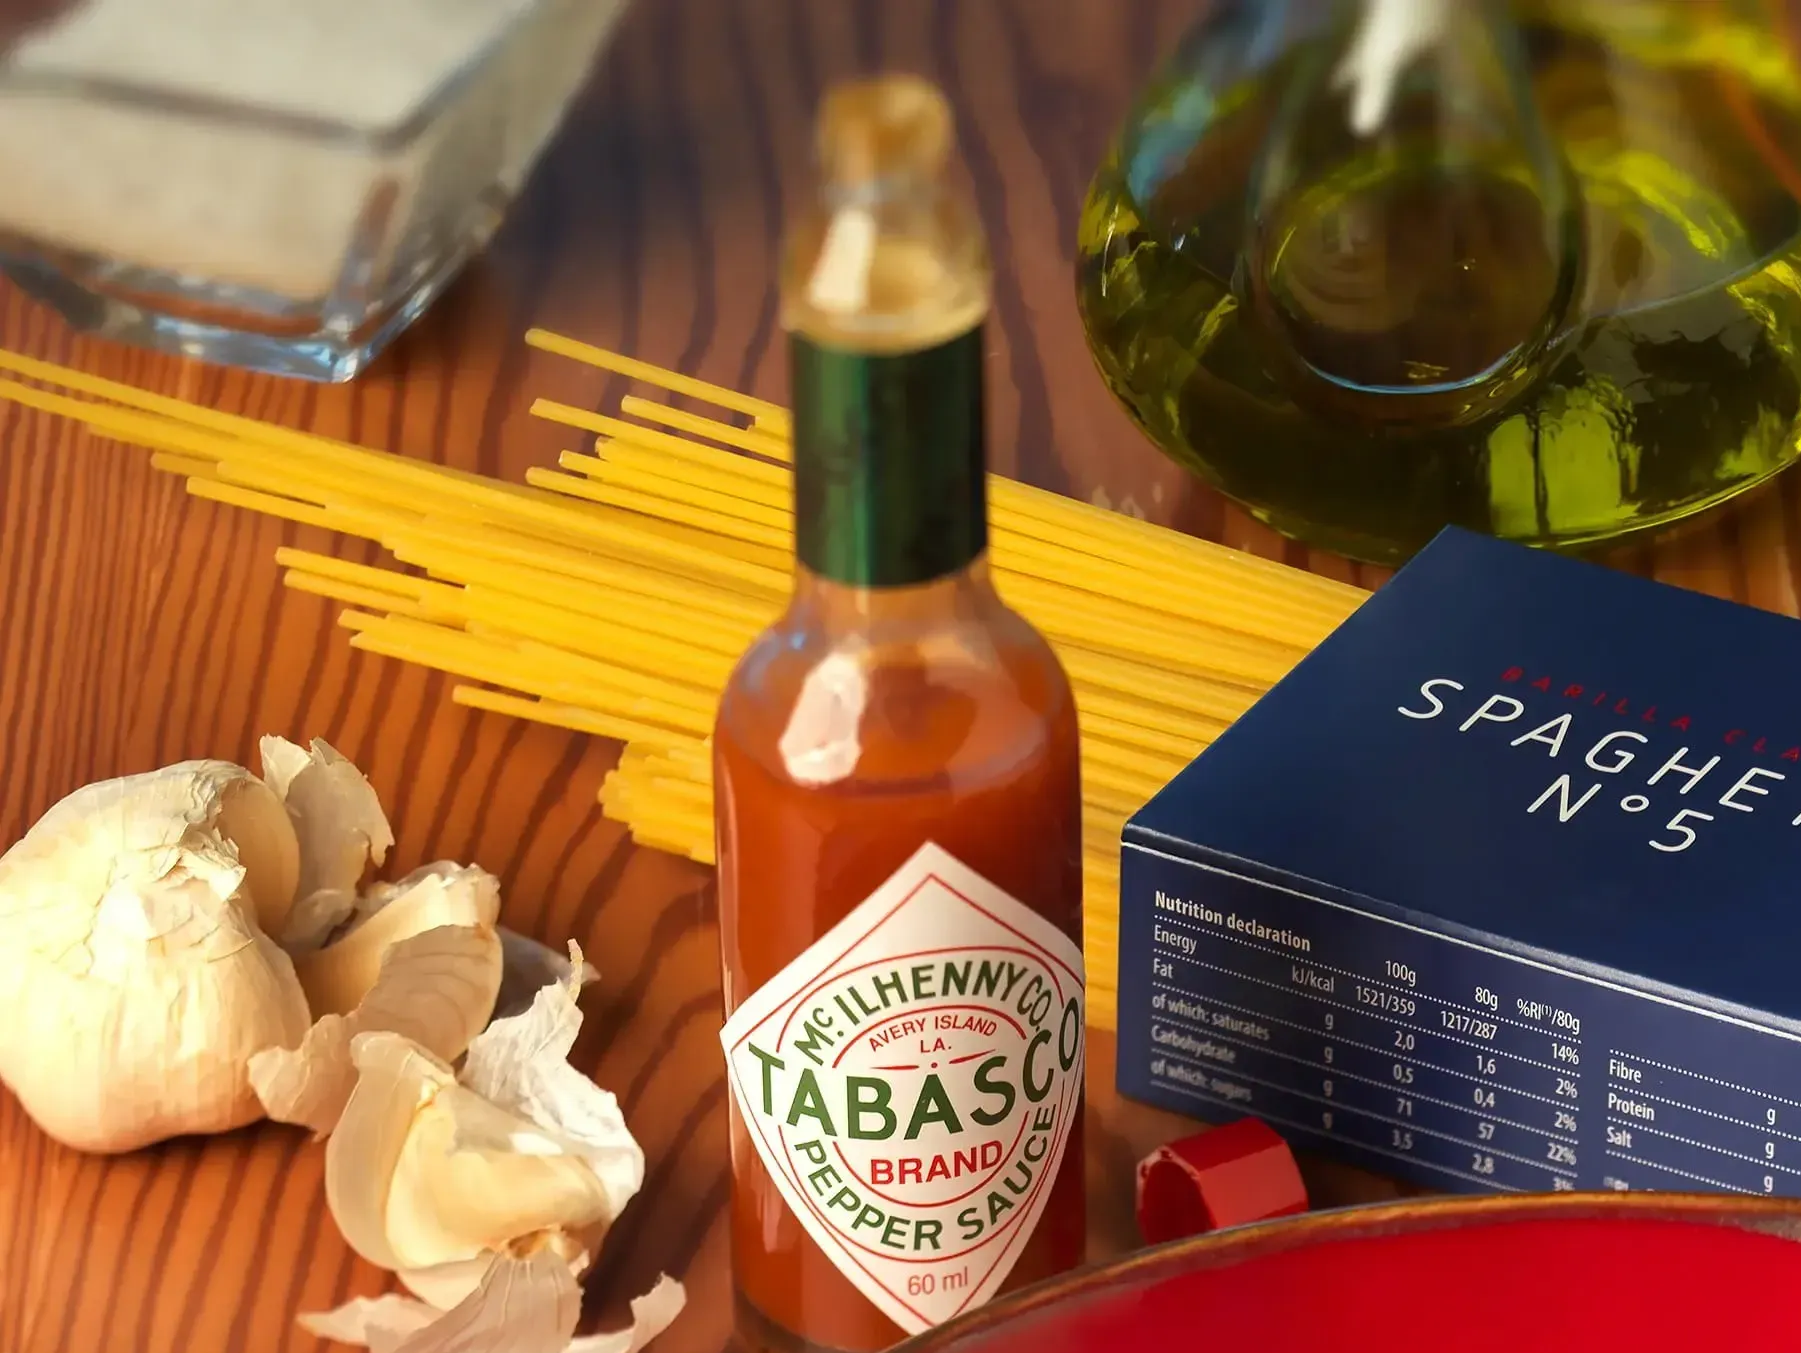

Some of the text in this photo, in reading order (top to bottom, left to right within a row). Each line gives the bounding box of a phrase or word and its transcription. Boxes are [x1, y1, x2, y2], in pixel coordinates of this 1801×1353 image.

[1501, 665, 1692, 732] BARILLA
[1155, 890, 1311, 952] Nutrition declaration
[1154, 924, 1580, 1065] Energy kJ/kcal 1521/359 1217/287 14%
[1385, 960, 1416, 987] 100g
[1475, 986, 1498, 1011] 80g
[868, 1015, 998, 1053] AVERY ISLAND
[919, 1038, 952, 1053] LA.
[1153, 958, 1578, 1098] Fat g 2,0 1,6 2%
[748, 997, 1080, 1141] TABASCO
[1152, 993, 1167, 1009] of
[1324, 1046, 1334, 1063] g
[1393, 1063, 1414, 1084] 0,5
[1473, 1088, 1495, 1109] 0,4
[1554, 1111, 1577, 1132] 2%
[1609, 1059, 1642, 1085] Fibre
[1766, 1106, 1777, 1126] g
[1478, 1122, 1495, 1141] 57
[1547, 1142, 1577, 1166] 22%
[1606, 1126, 1632, 1150] Salt
[1763, 1175, 1774, 1194] g
[1607, 1093, 1656, 1121] Protein
[1765, 1140, 1775, 1160] g
[794, 1103, 1057, 1252] PEPPER SAUCE
[870, 1140, 1003, 1185] BRAND
[908, 1265, 968, 1296] 60 ml
